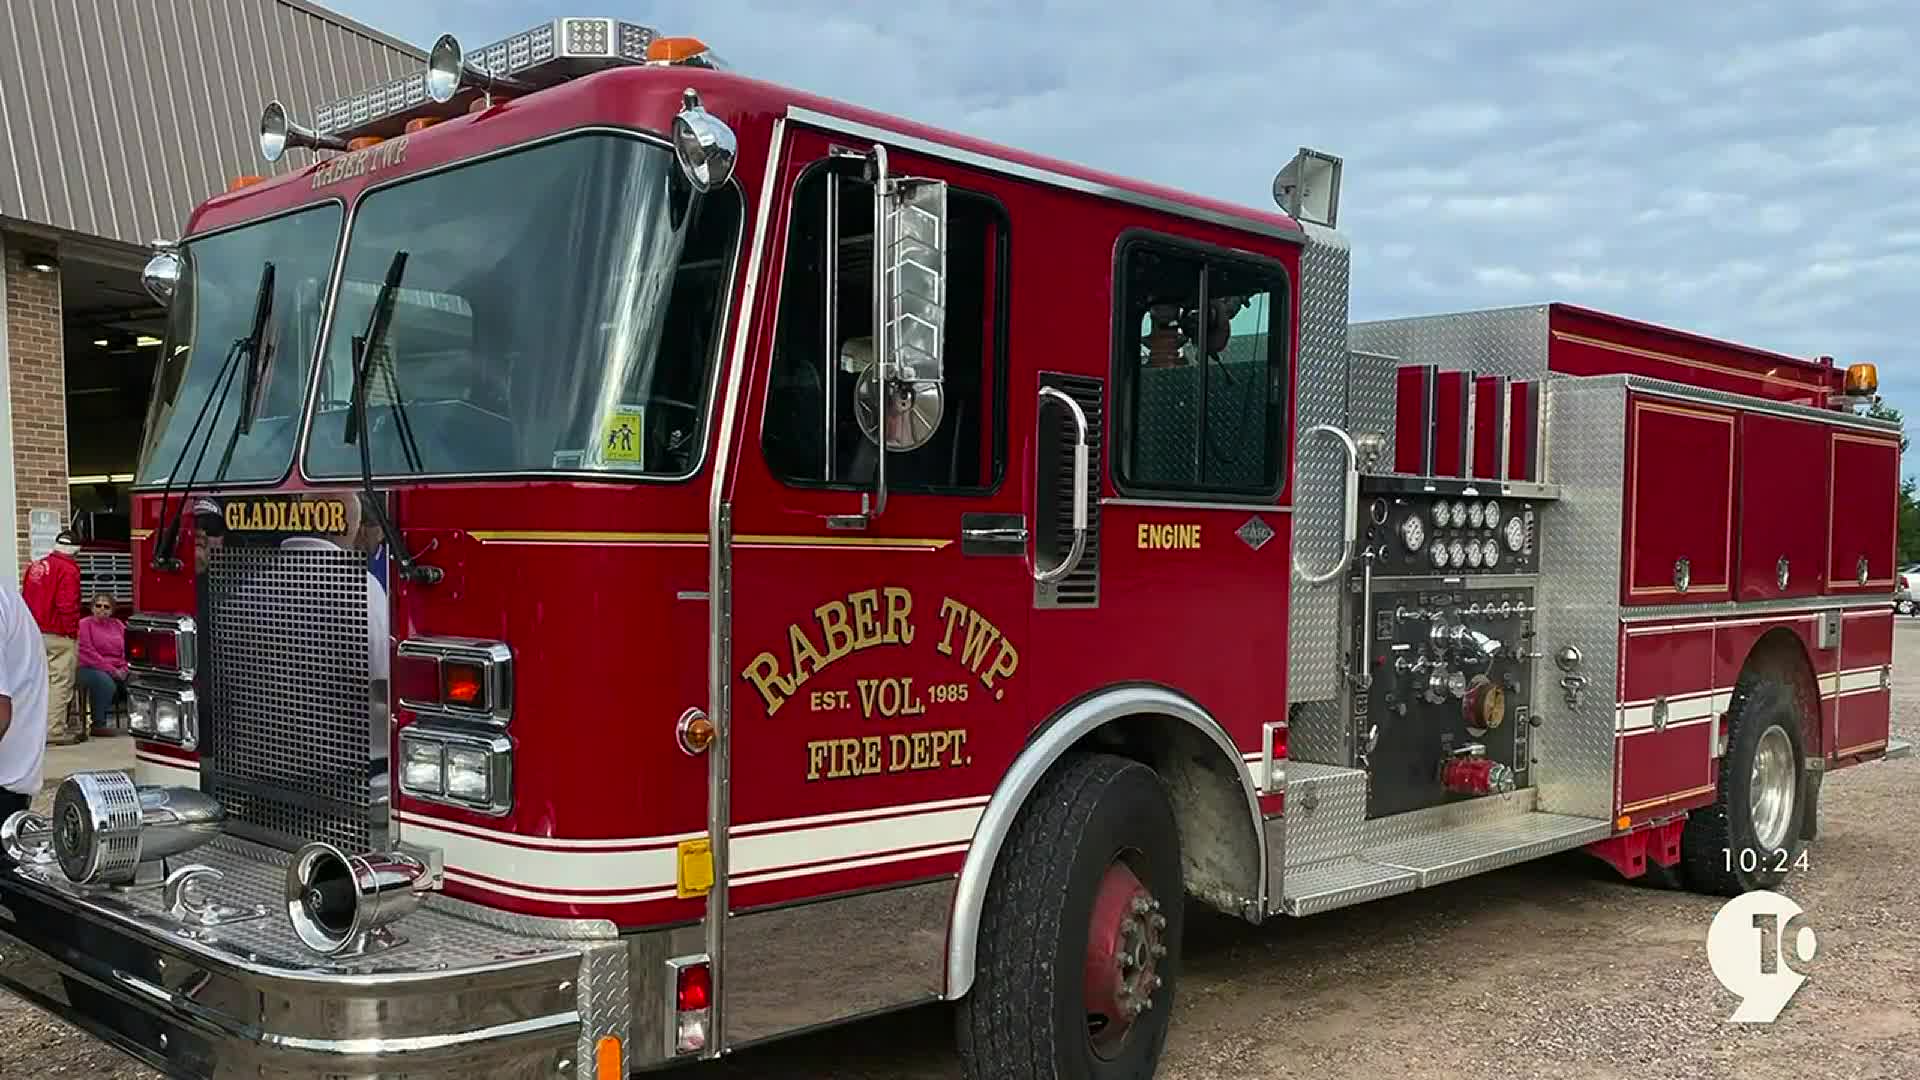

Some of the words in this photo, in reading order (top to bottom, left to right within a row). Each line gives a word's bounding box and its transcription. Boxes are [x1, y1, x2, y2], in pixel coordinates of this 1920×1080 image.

[311, 150, 369, 190] RABER
[225, 501, 346, 532] GLADIATOR
[1137, 523, 1201, 549] ENGINE
[741, 586, 915, 716] RABER
[936, 596, 1019, 700] TWP.
[810, 690, 851, 712] EST.
[856, 677, 926, 718] VOL.
[928, 684, 969, 703] 1985
[806, 735, 882, 780] FIRE
[888, 729, 972, 773] DEPT.
